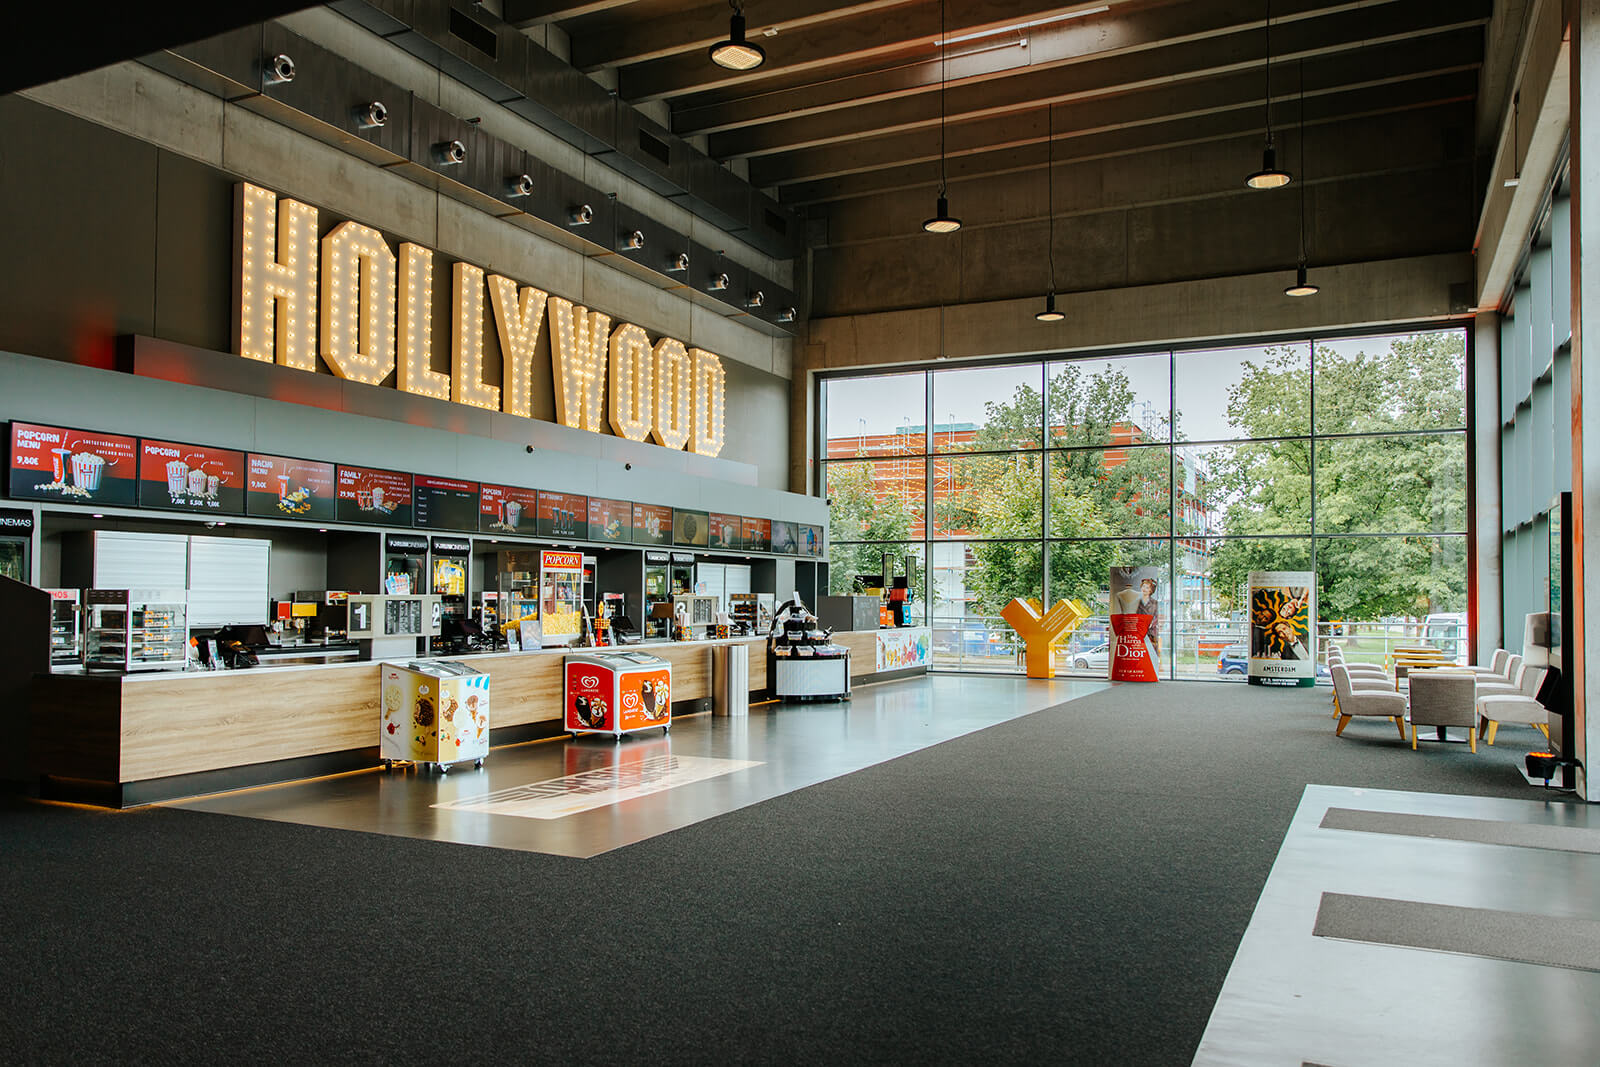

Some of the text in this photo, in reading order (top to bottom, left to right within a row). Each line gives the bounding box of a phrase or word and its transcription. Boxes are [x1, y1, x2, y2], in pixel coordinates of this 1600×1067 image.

[233, 182, 726, 458] HOLLYWOOD
[17, 430, 60, 443] POPCORN
[17, 439, 41, 449] MENU
[145, 445, 180, 458] POPCORN
[340, 469, 362, 480] FAMILY
[545, 555, 579, 565] POPCORN
[354, 604, 366, 629] 1
[432, 602, 441, 629] 2
[1117, 644, 1147, 658] Dior
[1263, 665, 1297, 673] AMSTERDAM
